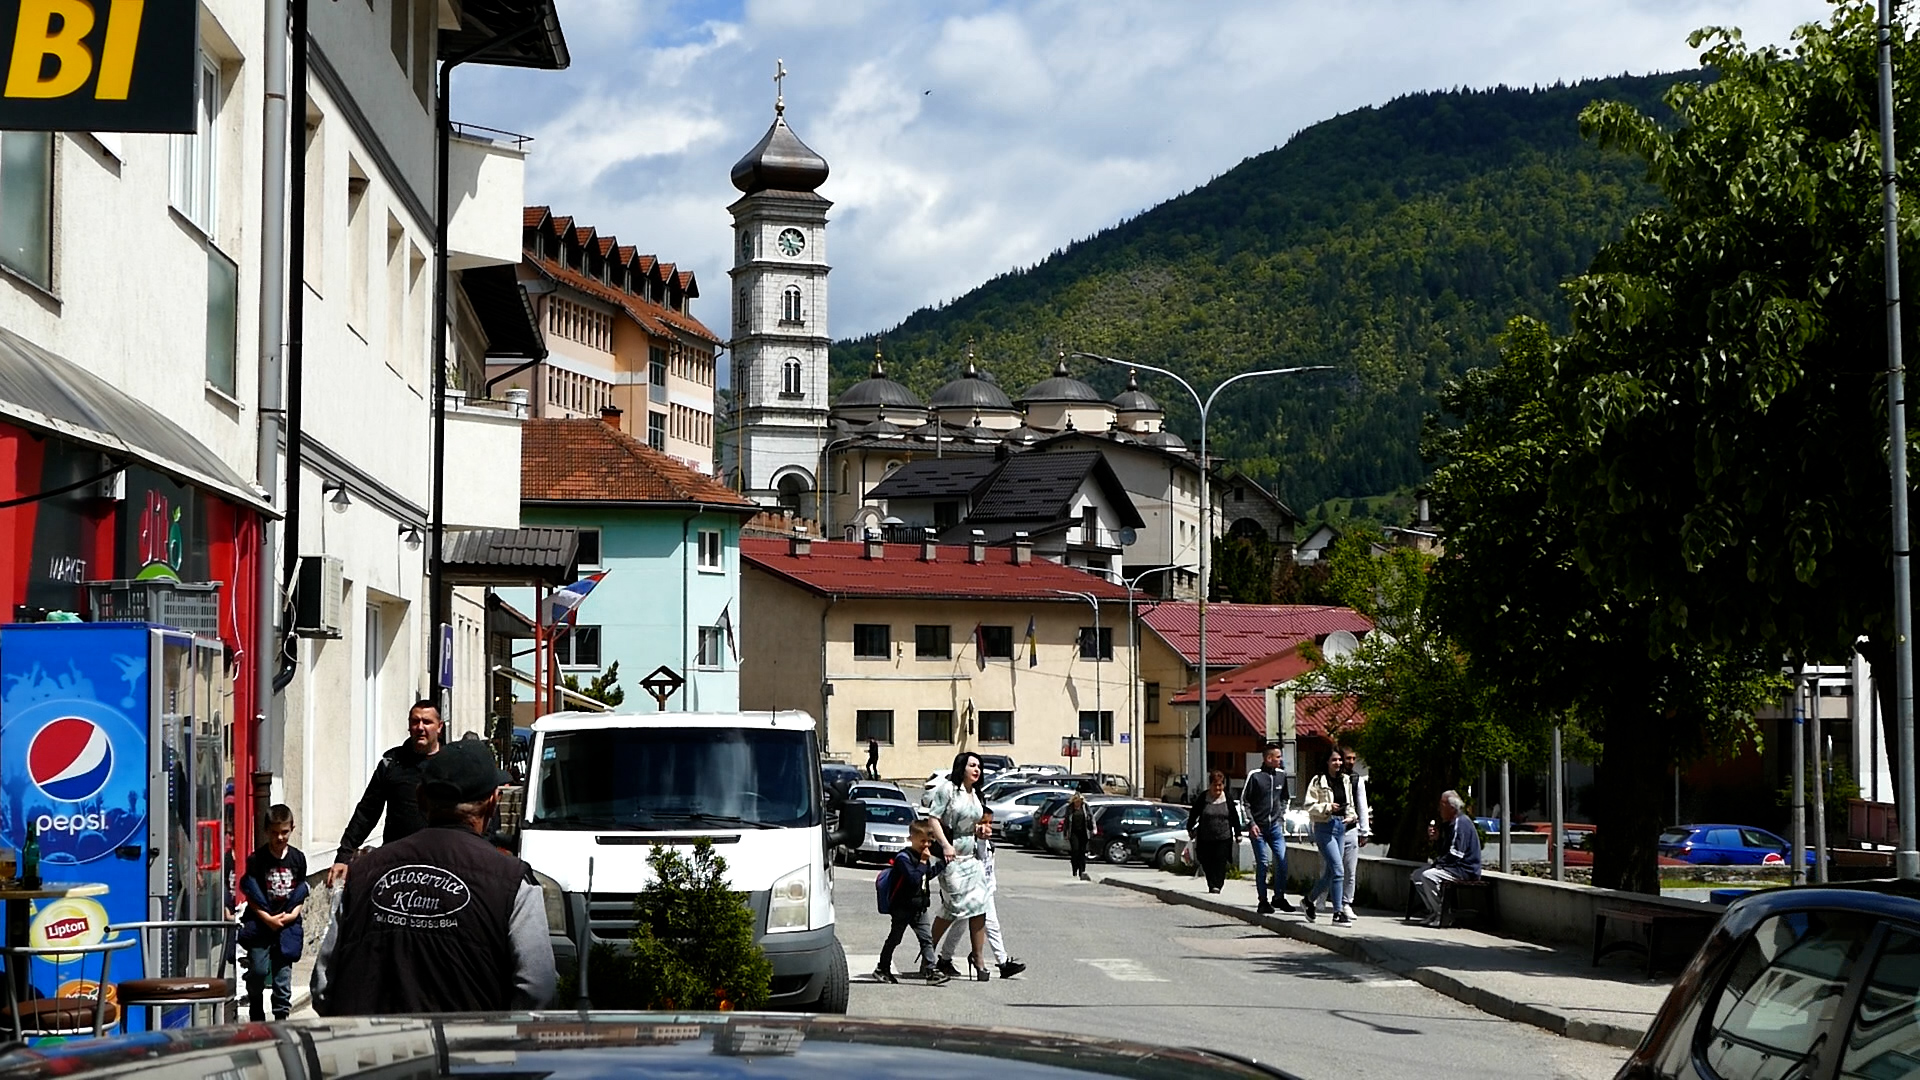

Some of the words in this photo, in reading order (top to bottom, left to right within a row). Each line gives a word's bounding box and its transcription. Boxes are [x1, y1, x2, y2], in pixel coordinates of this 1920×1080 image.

[49, 556, 87, 584] MARKET
[444, 637, 452, 675] P
[36, 810, 106, 836] pepsi
[378, 870, 464, 895] Autoservice
[391, 889, 440, 911] Klann
[48, 920, 86, 938] Lipton
